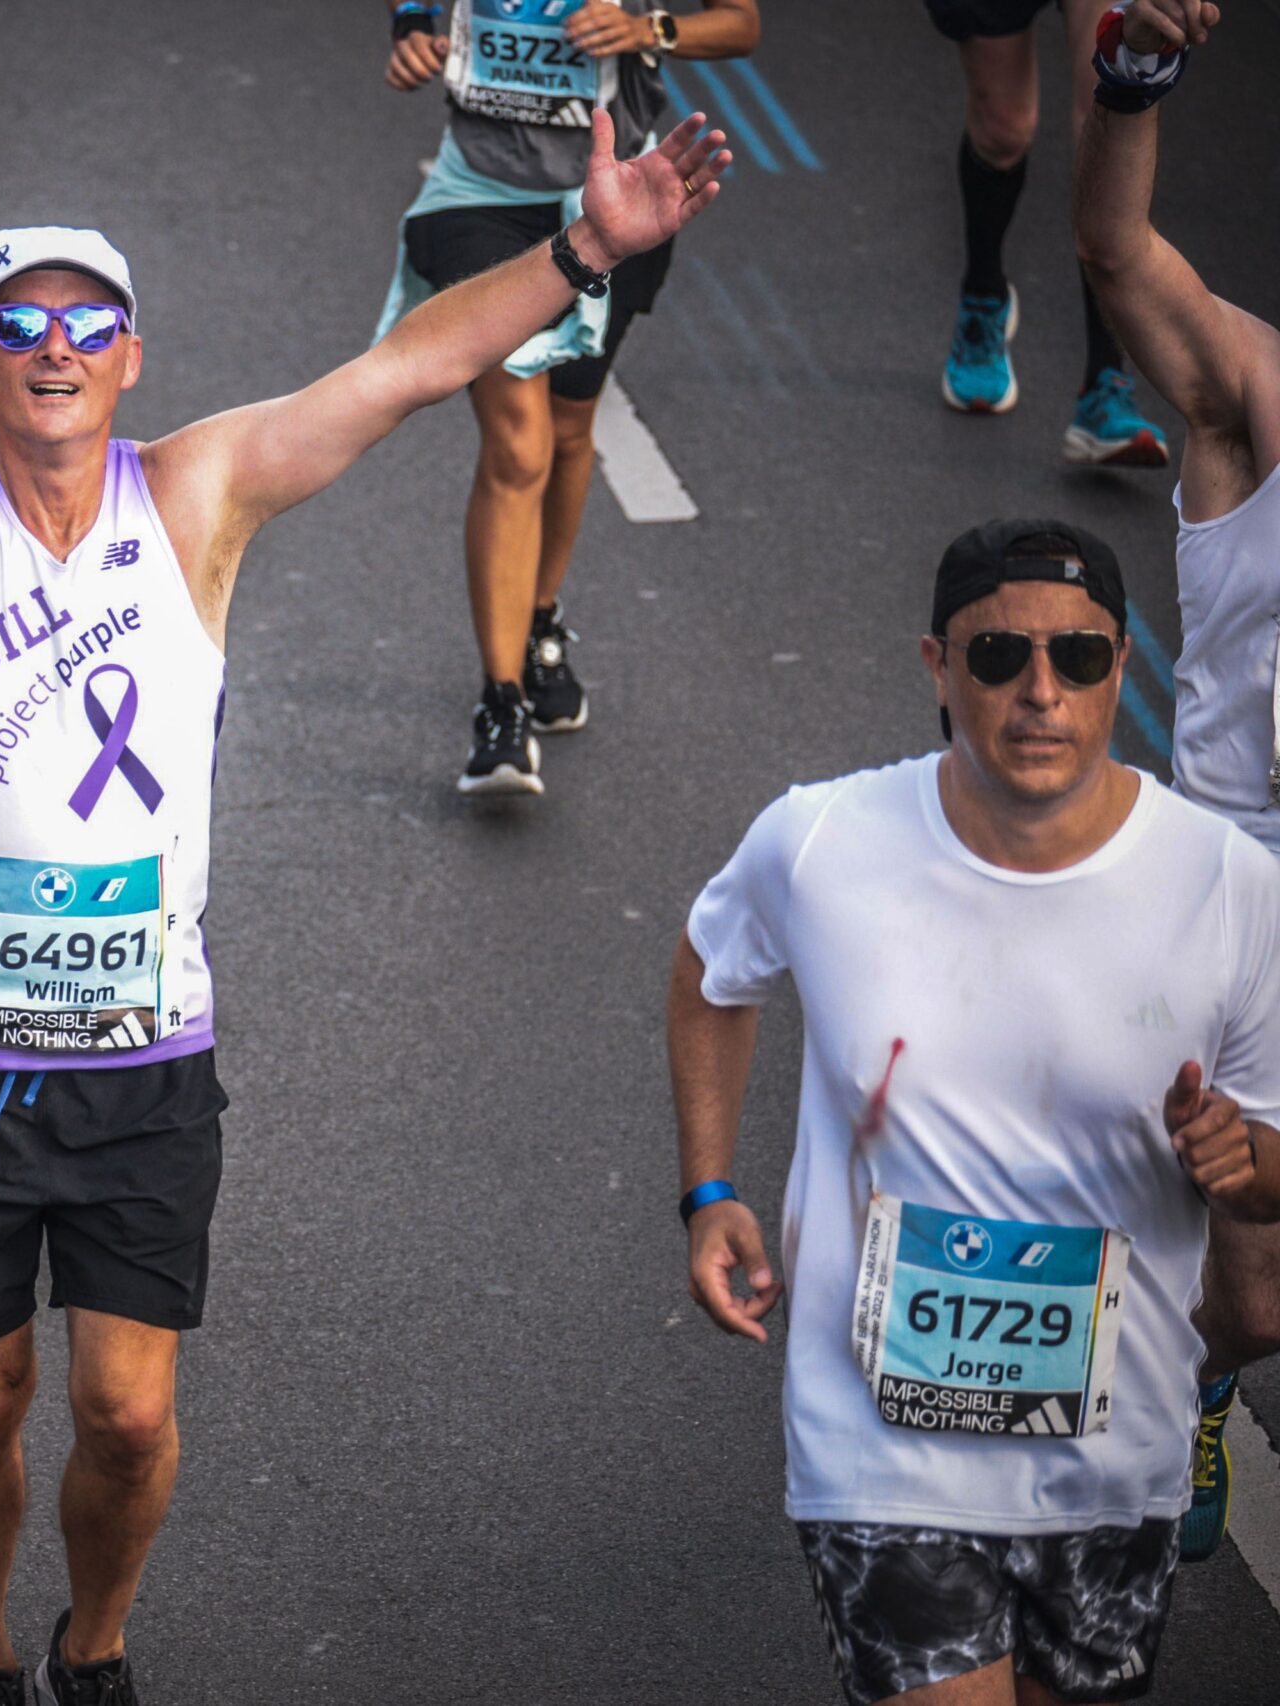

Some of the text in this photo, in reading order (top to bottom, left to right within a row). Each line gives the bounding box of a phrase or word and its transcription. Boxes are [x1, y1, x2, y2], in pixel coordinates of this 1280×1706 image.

[478, 31, 586, 68] 63722
[490, 68, 573, 89] JUANITA
[167, 913, 177, 931] F
[24, 979, 116, 1005] William
[2, 1026, 92, 1049] NOTHING
[1104, 1290, 1120, 1310] H
[865, 1290, 885, 1376] September 2023
[906, 1289, 1073, 1347] 61729
[940, 1352, 1023, 1386] Jorge
[881, 1377, 1014, 1413] IMPOSSIBLE
[881, 1400, 1006, 1433] IS NOTHING
